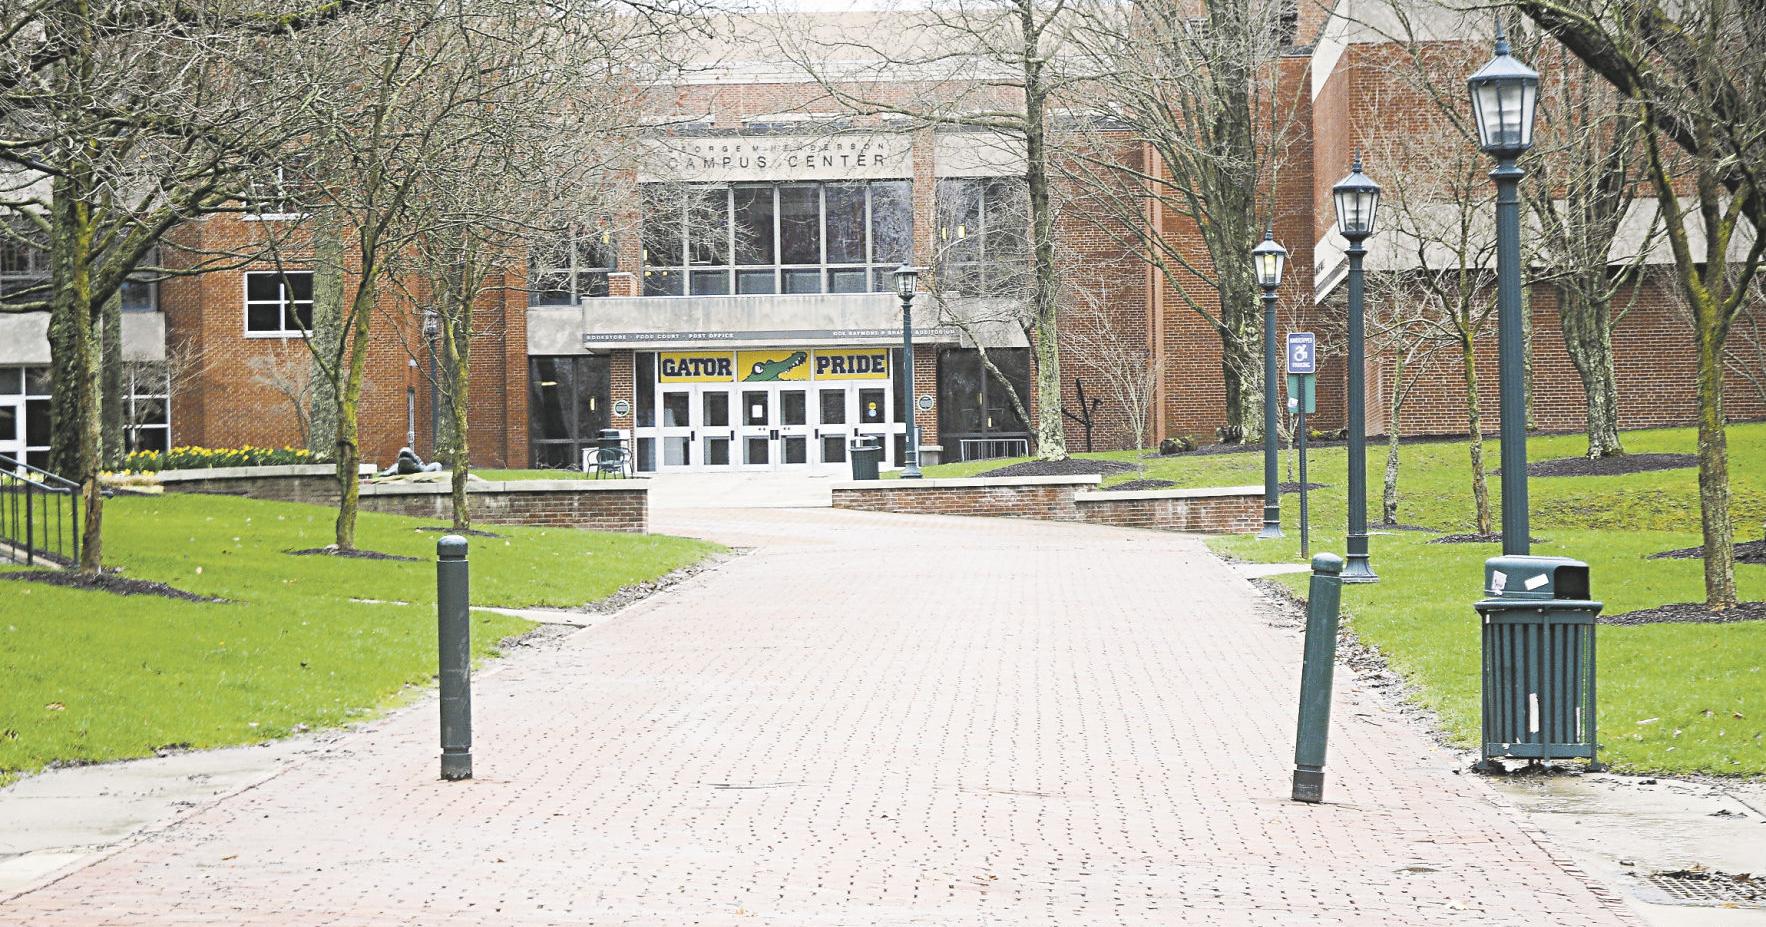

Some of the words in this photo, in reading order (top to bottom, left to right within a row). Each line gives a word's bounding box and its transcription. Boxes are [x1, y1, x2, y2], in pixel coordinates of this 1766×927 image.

[669, 155, 767, 169] CAMPUS
[788, 154, 885, 169] CENTER
[662, 357, 732, 376] GATOR
[816, 354, 885, 374] PRIDE
